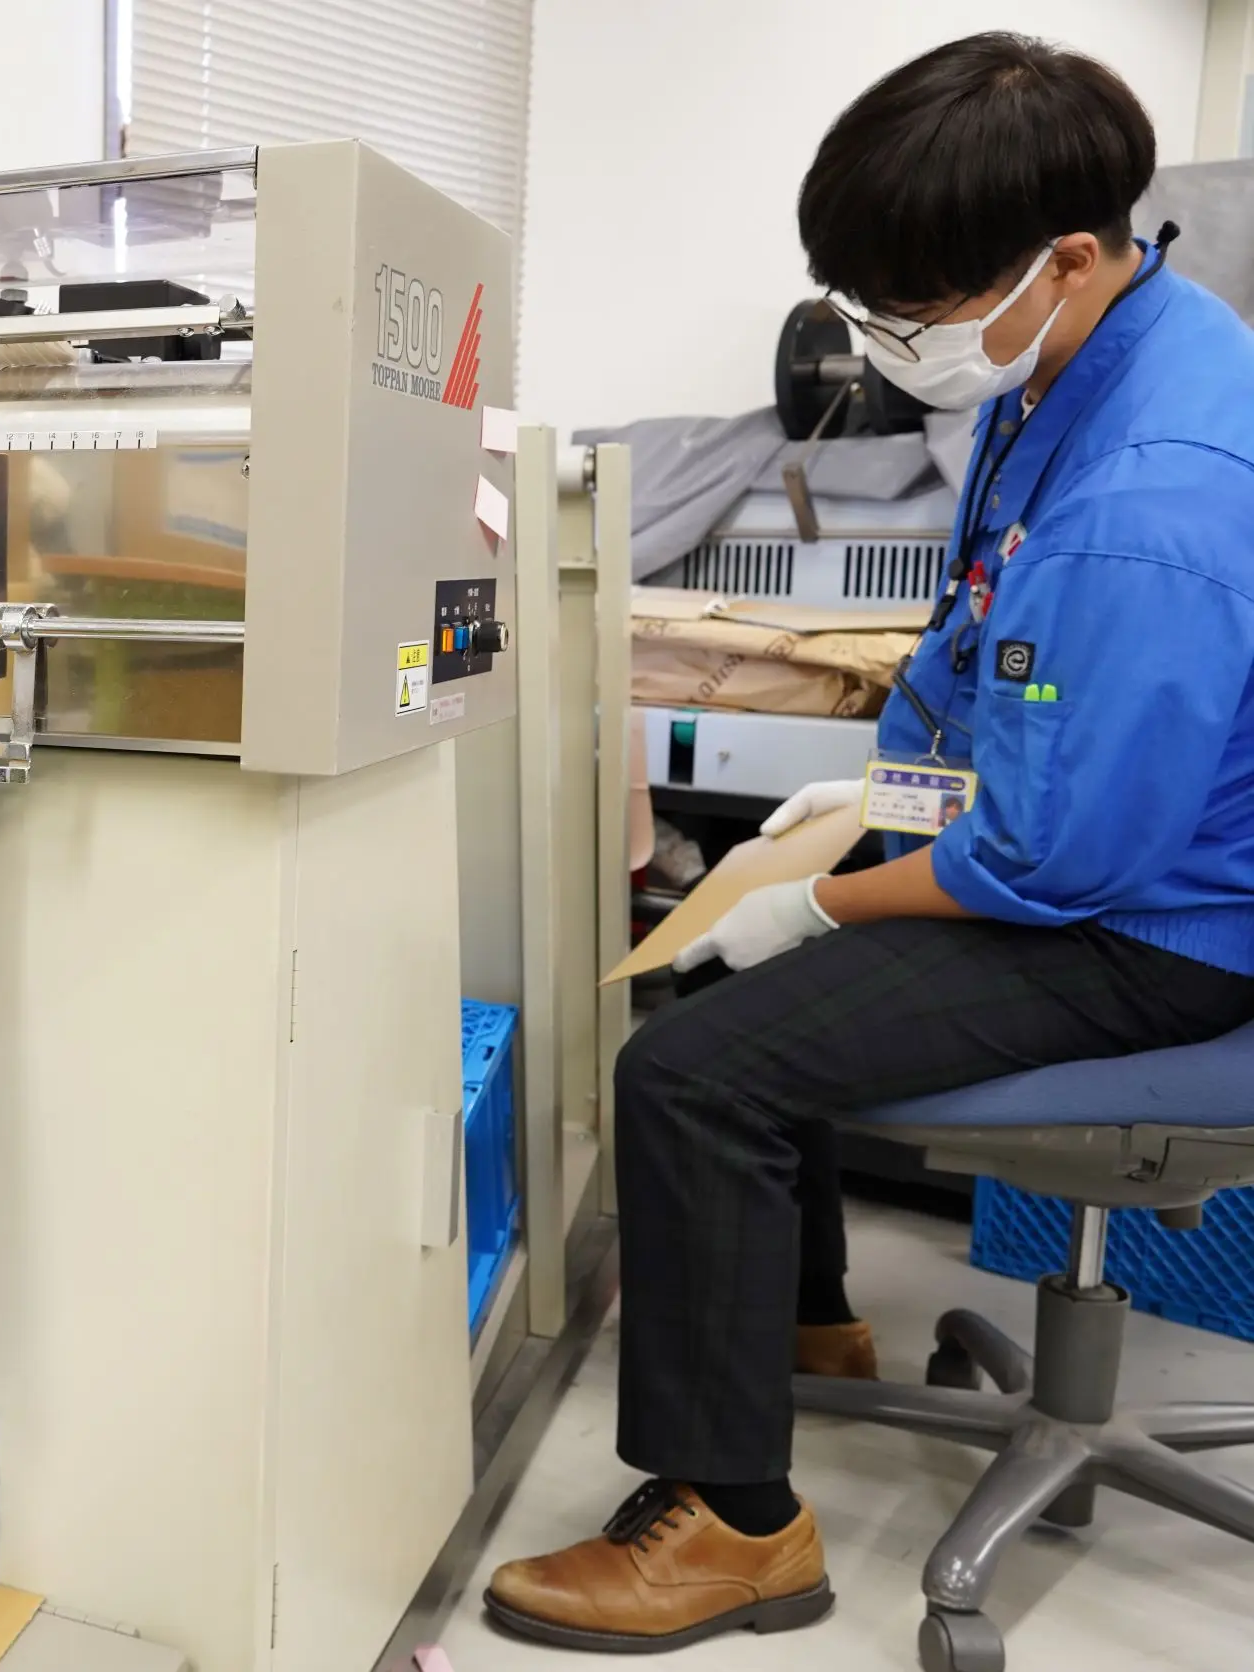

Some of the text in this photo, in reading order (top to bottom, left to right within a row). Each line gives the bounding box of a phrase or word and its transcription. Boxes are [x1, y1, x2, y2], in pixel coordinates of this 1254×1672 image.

[375, 264, 443, 375] 1500
[372, 363, 441, 402] TOPPAN MOORE
